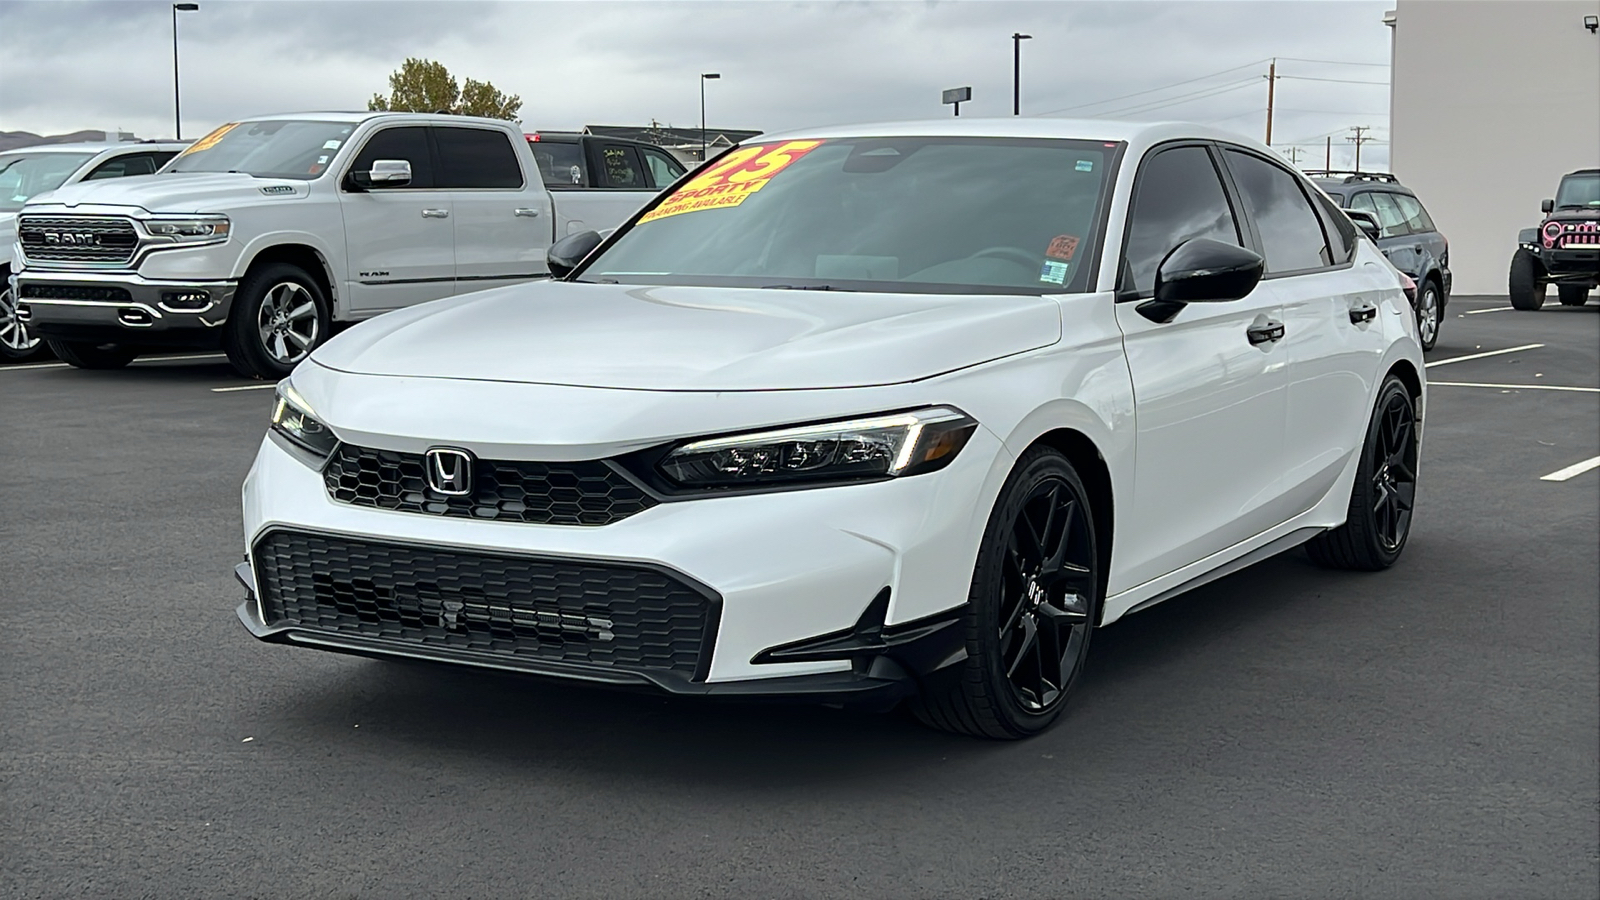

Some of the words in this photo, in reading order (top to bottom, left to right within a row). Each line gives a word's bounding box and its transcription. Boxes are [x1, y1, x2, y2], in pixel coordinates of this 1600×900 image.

[665, 181, 763, 205] SPORTY
[690, 195, 746, 209] AVAILABLE
[44, 232, 93, 245] RAM
